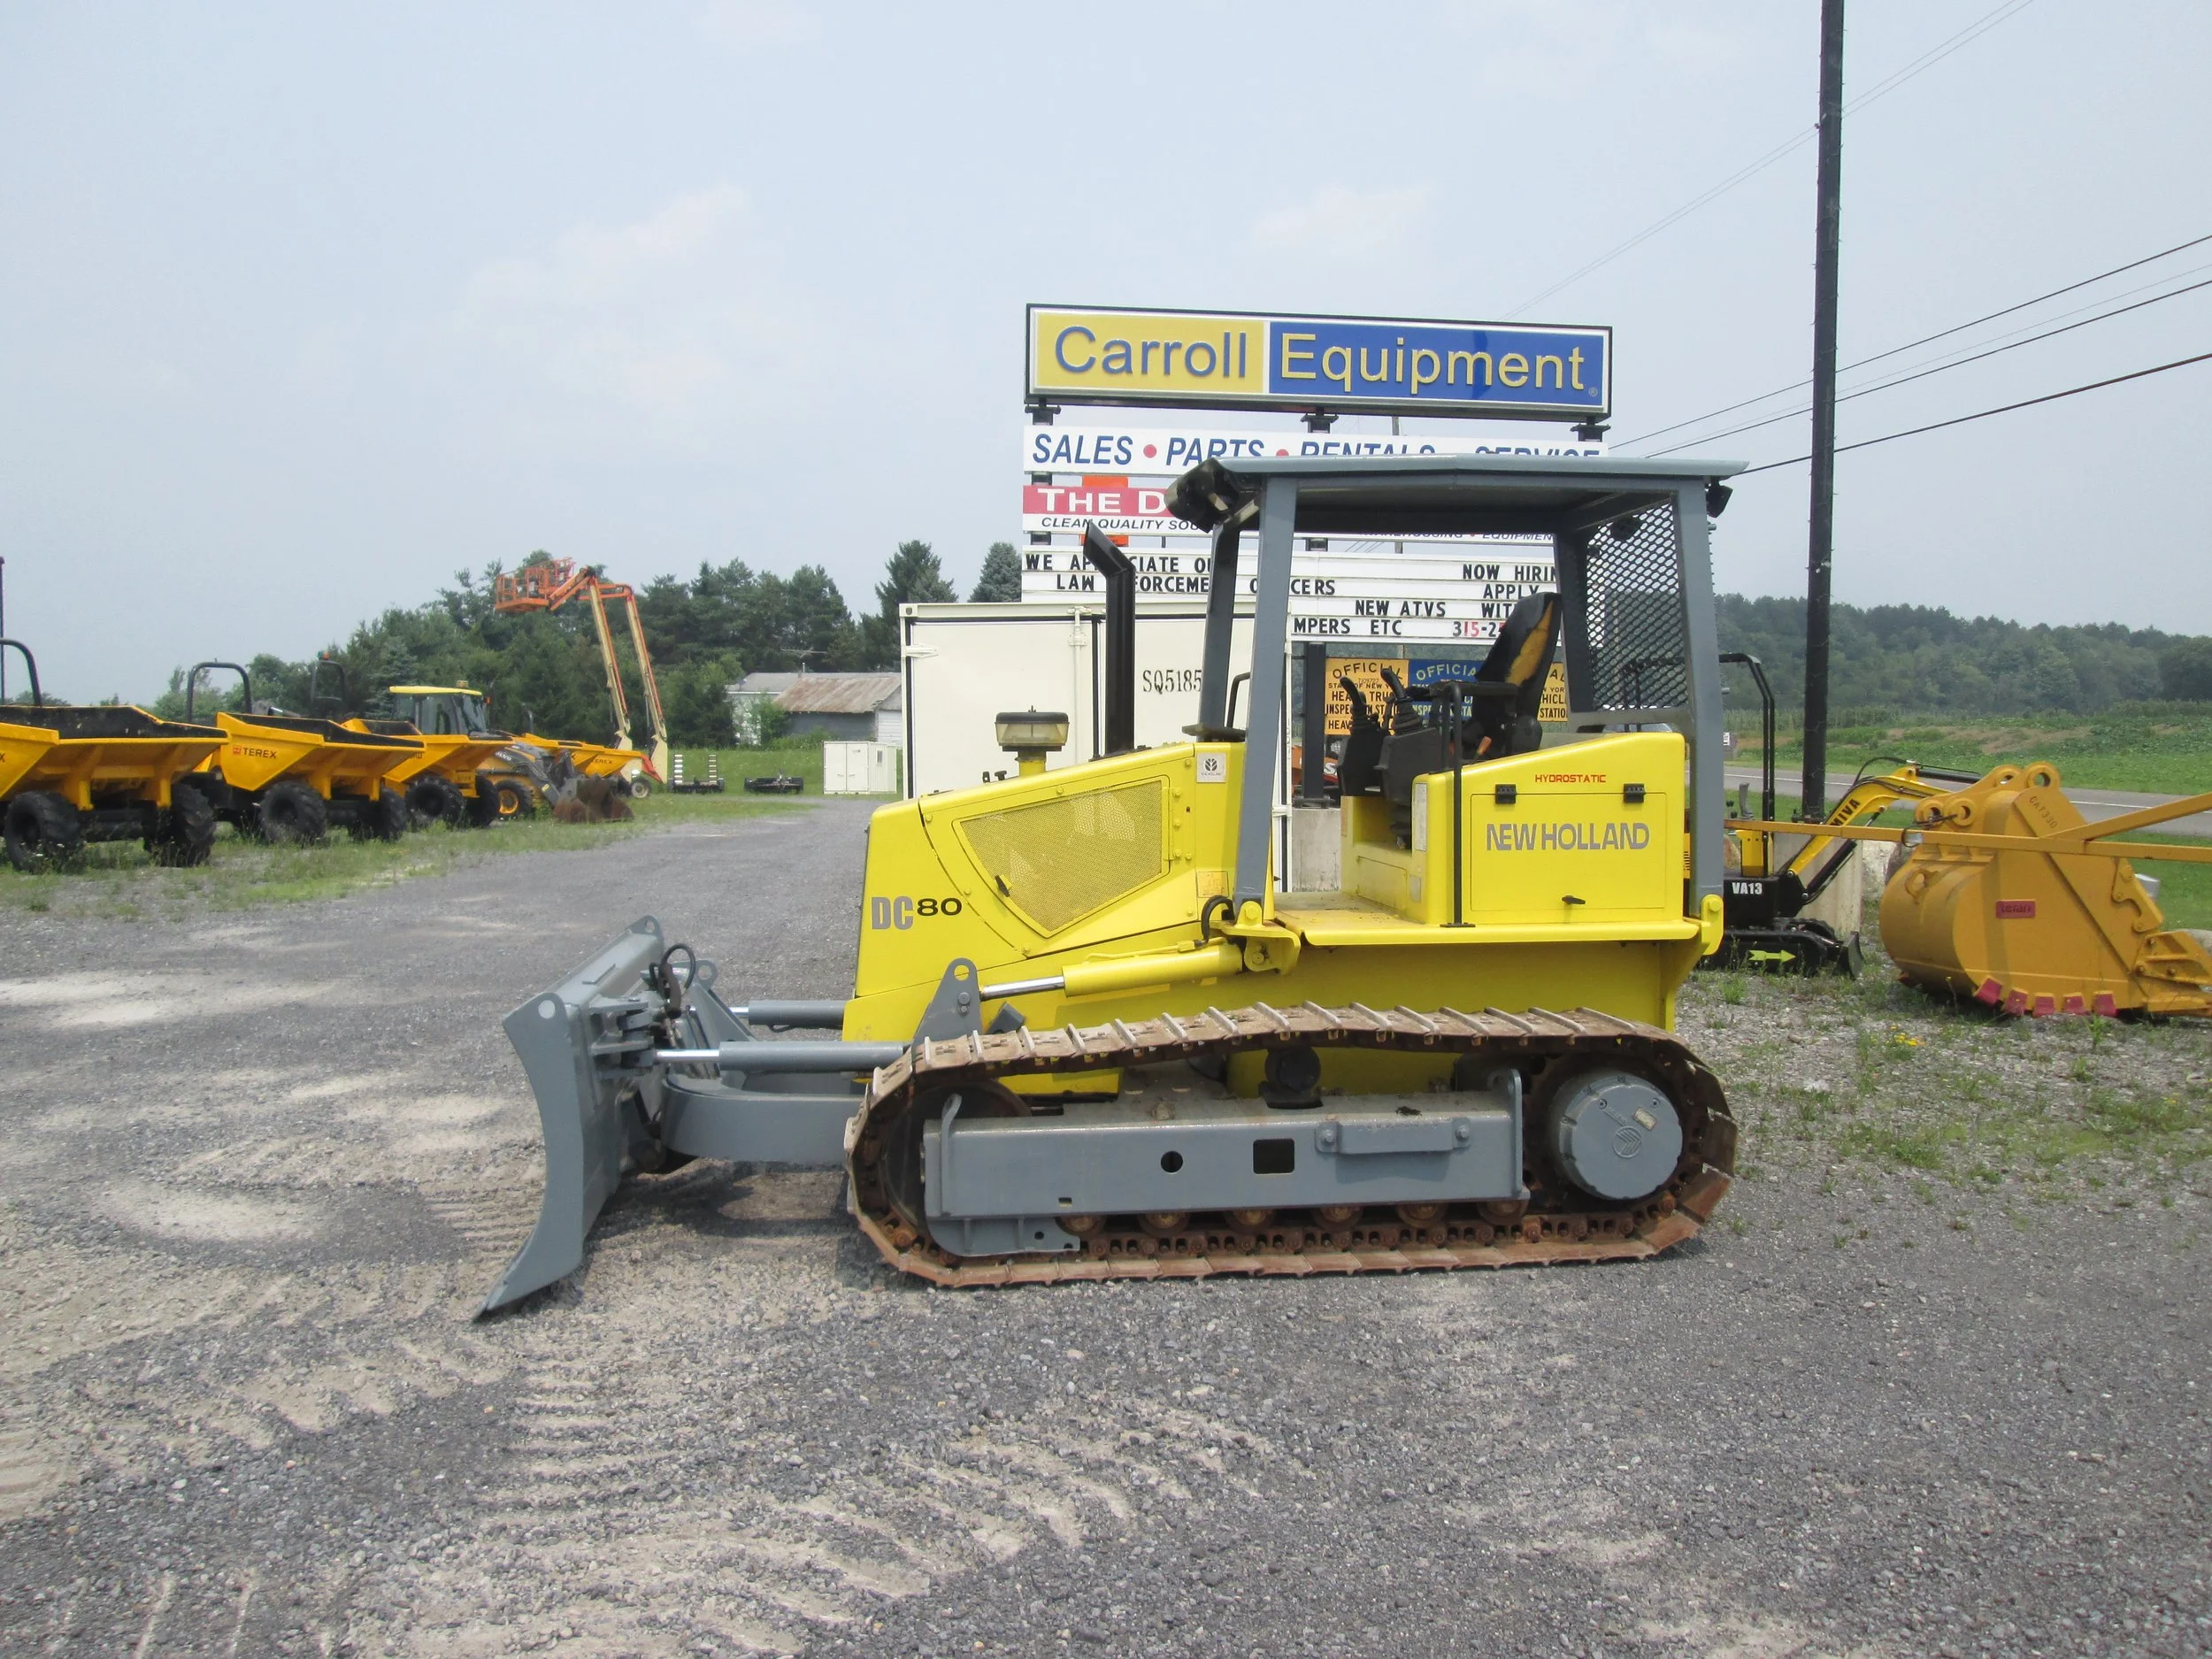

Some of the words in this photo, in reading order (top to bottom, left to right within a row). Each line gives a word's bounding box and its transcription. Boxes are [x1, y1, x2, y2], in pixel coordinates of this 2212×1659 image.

[1055, 326, 1247, 378] Carroll
[1281, 333, 1585, 395] Equipment
[1033, 434, 1133, 465] SALES
[1165, 437, 1265, 466] PARTS
[1037, 488, 1121, 513] THE
[1041, 517, 1094, 528] CLEAN
[1098, 518, 1164, 530] QUALITY
[1025, 554, 1053, 571] WE
[1463, 564, 1500, 580] NOW
[1056, 574, 1094, 591] LAW
[1355, 600, 1390, 617] NEW
[1400, 601, 1447, 618] ATVS
[1481, 603, 1514, 618] WIT
[1371, 619, 1402, 635] ETC
[242, 747, 277, 759] TEREX
[1534, 774, 1607, 783] HYDROSTATIC
[1486, 823, 1537, 850] NEW
[1541, 822, 1650, 850] HOLLAND
[1732, 882, 1763, 895] VA13
[871, 895, 914, 930] DC
[917, 897, 963, 917] 80
